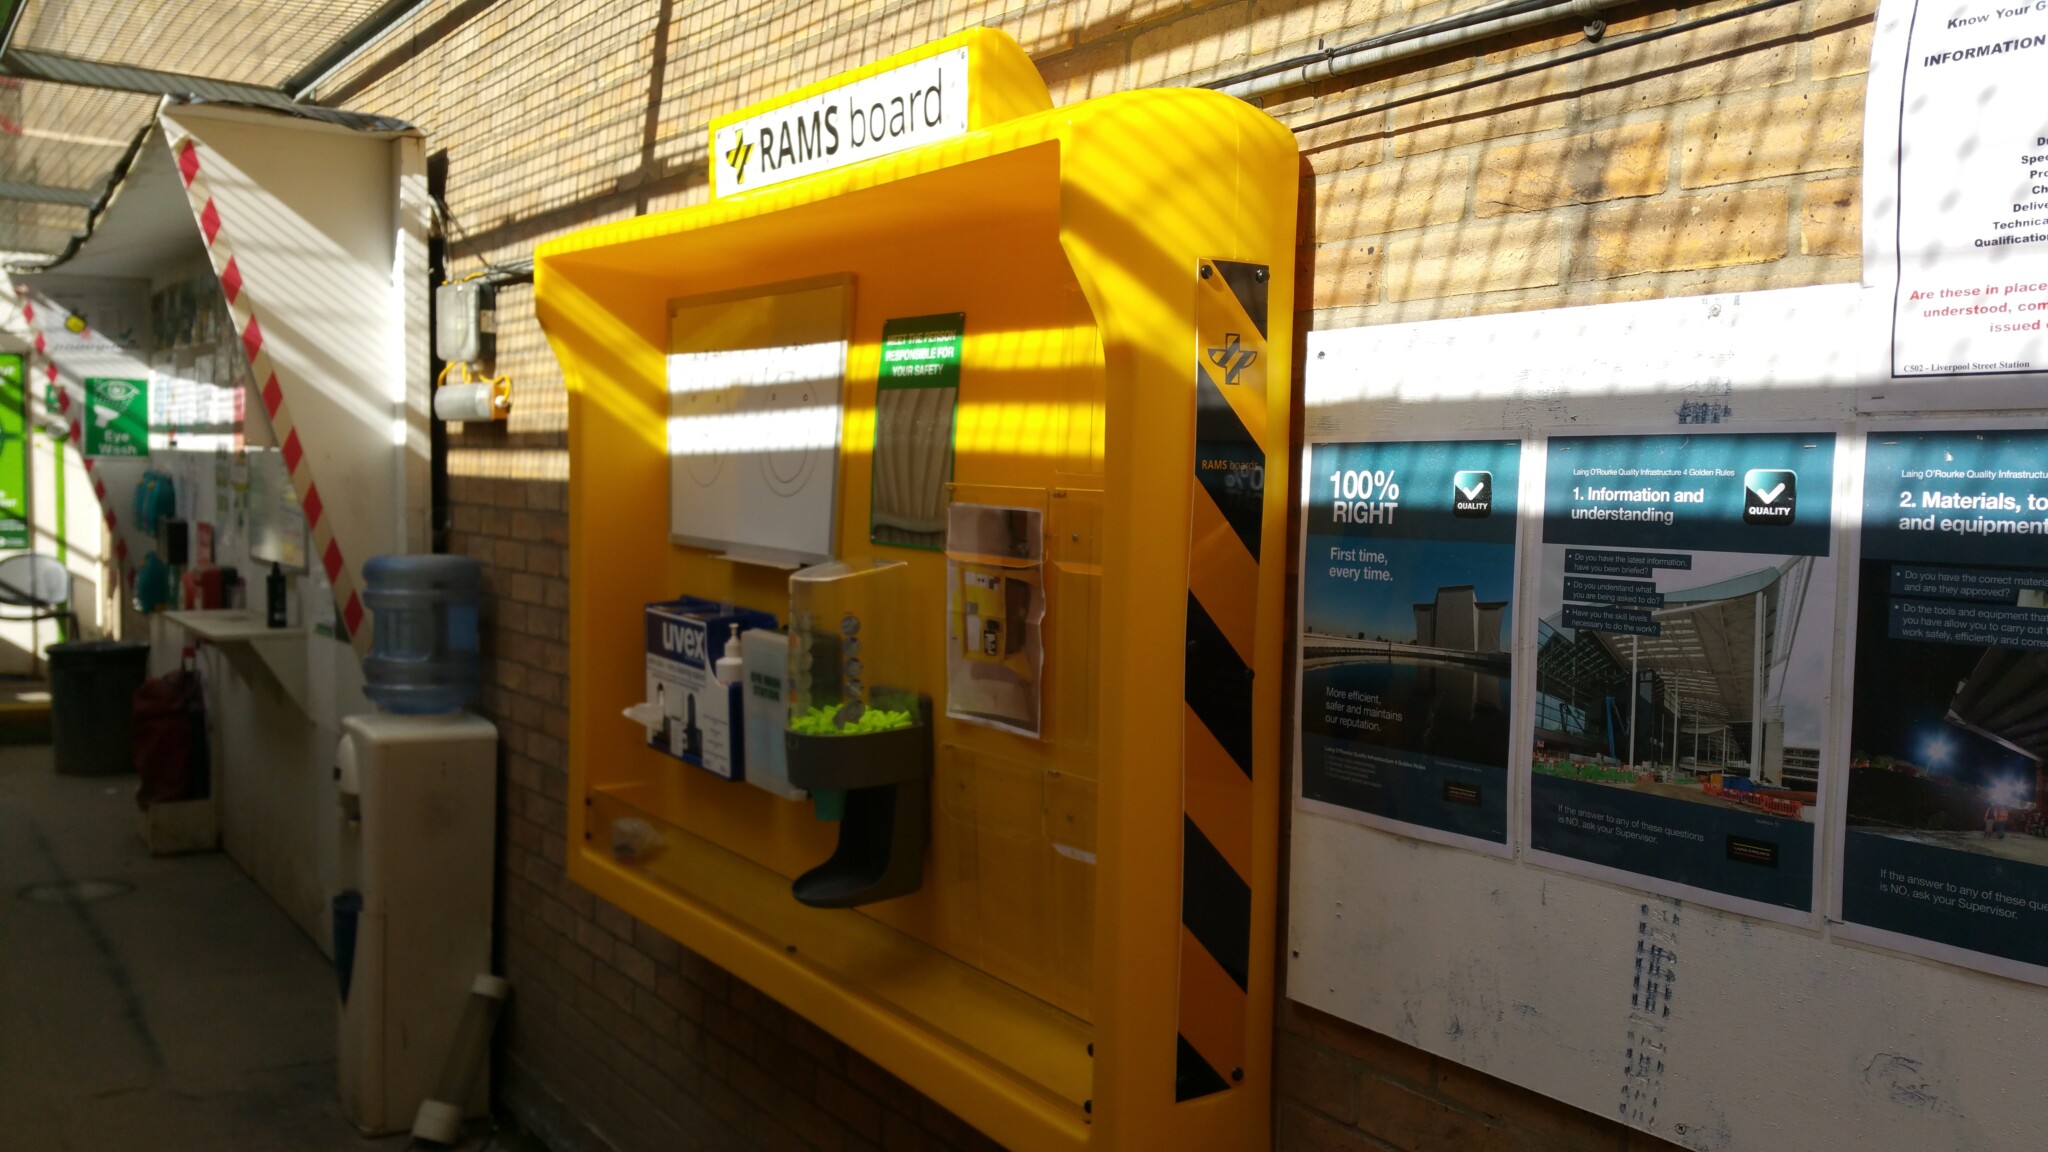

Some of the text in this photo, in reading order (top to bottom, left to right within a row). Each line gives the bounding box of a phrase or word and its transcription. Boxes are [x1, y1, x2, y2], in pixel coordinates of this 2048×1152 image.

[1947, 5, 2031, 29] Know Your
[1924, 34, 2047, 68] INFORMATION
[759, 67, 942, 173] RAMS board
[1974, 233, 2048, 248] Qualificatio
[1910, 282, 2048, 301] Are these in place
[1924, 302, 2012, 317] understood,
[1990, 320, 2041, 332] issued
[887, 330, 956, 346] MEET THE PERSON
[938, 346, 954, 359] FOR
[892, 362, 944, 377] YOUR SAFETY
[1904, 361, 2030, 373] C502 Liverpool Street Station
[104, 429, 129, 443] Eye
[1202, 460, 1228, 470] RAMS
[1573, 468, 1590, 478] Laing
[1618, 468, 1640, 478] Quality
[1640, 468, 1682, 476] Infrastructure
[1689, 468, 1714, 477] Golden
[1716, 468, 1735, 477] Rules
[1902, 470, 1924, 480] Laing
[1925, 469, 1965, 478] O'Rourke
[1966, 470, 1996, 480] Quality
[1330, 470, 1400, 500] 100%
[1572, 486, 1704, 503] 1. Information and
[1900, 490, 1916, 508] 2.
[1922, 491, 2021, 514] Materials,
[1333, 501, 1398, 525] RIGHT
[1457, 502, 1488, 511] QUALITY
[1748, 506, 1790, 516] QUALITY
[1571, 506, 1674, 526] understanding
[1898, 514, 1935, 531] and
[1330, 547, 1388, 566] First time,
[1574, 553, 1584, 561] Do
[1586, 555, 1597, 564] you
[1598, 554, 1614, 562] have
[1616, 555, 1626, 563] the
[1628, 556, 1646, 564] latest
[1329, 566, 1394, 582] every time.
[1574, 563, 1648, 575] have you been briefed?
[1904, 570, 1918, 580] Do
[1920, 573, 1936, 582] you
[1938, 572, 1960, 582] have
[1962, 574, 1976, 583] the
[1978, 575, 2012, 585] correct
[1574, 581, 1652, 594] Do you understand what
[1904, 582, 1920, 592] and
[1939, 584, 1958, 596] they
[1960, 586, 2010, 598] approved?
[1572, 592, 1585, 602] you
[1598, 592, 1616, 602] being
[1617, 594, 1636, 602] asked
[1646, 596, 1660, 606] do?
[1572, 608, 1648, 622] Have you the skill levels
[1903, 604, 1916, 612] Do
[1918, 604, 1932, 614] the
[1934, 606, 1956, 616] tools
[1958, 607, 1976, 617] and
[1978, 608, 2028, 621] equipment
[1572, 621, 1656, 634] necessary do the work?
[1902, 617, 1918, 626] you
[1920, 616, 1942, 626] have
[1944, 618, 1968, 628] allow
[1969, 622, 1986, 632] you
[1989, 621, 1998, 631] to
[2000, 624, 2025, 634] carry
[2027, 624, 2044, 634] out
[662, 621, 705, 660] uvex
[1902, 628, 1924, 638] work
[1925, 630, 1952, 641] safely,
[1955, 632, 1998, 644] efficiently
[2000, 636, 2019, 645] and
[1326, 686, 1381, 706] More efficient,
[1326, 702, 1402, 722] safer and maintains
[1325, 715, 1382, 732] our reputation.
[1564, 806, 1704, 842] the answer any of these questions
[1566, 816, 1658, 844] NO, ask your Supervisor.
[1880, 868, 1888, 878] If
[1888, 870, 1905, 882] the
[1907, 876, 1944, 890] answer
[1946, 882, 1957, 894] to
[1959, 888, 1978, 900] any
[1981, 890, 1994, 900] of
[1994, 892, 2026, 907] these
[1880, 882, 2018, 920] is NO, ask your Supervisor.
